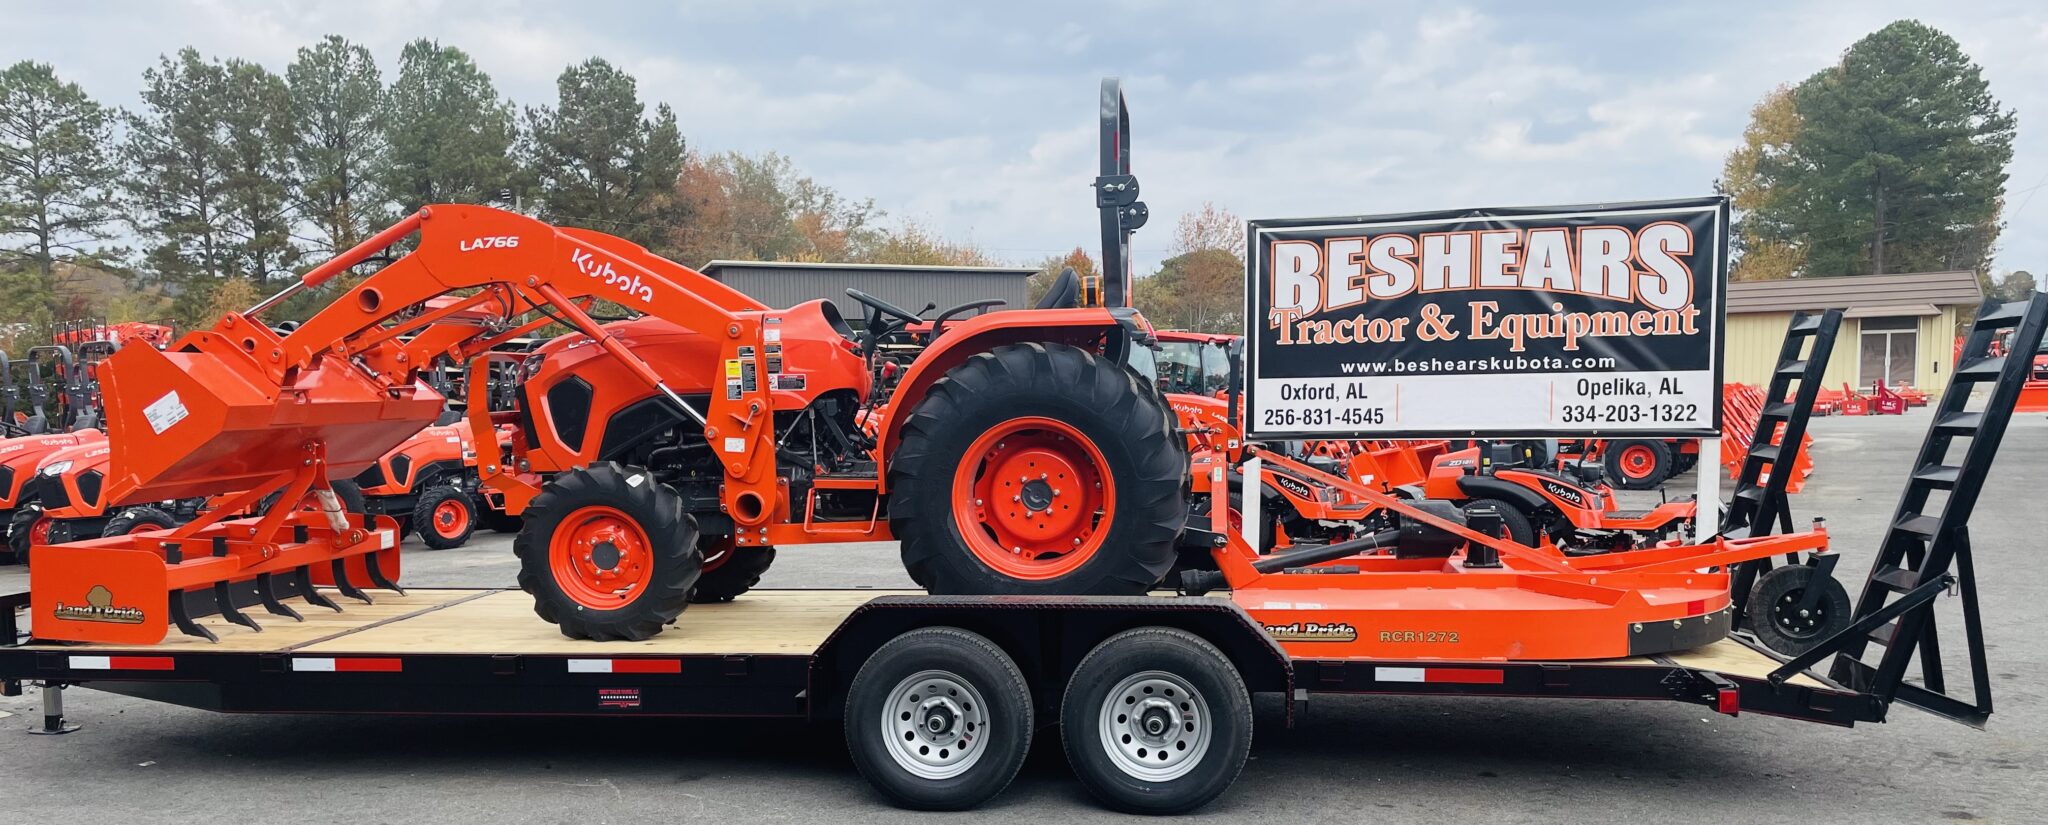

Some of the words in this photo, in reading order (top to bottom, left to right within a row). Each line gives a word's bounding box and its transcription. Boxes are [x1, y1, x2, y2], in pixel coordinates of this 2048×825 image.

[460, 236, 519, 252] LA766
[571, 248, 654, 303] Kubota
[1270, 220, 1695, 329] BESHEARS
[1268, 305, 1409, 346] Tractor
[1416, 302, 1460, 341] &
[1468, 301, 1700, 352] Equipment
[1341, 356, 1616, 373] www.beshearskubota.com
[1281, 383, 1340, 402] Oxford,
[1346, 382, 1368, 399] AL
[1577, 378, 1652, 399] Opelika,
[1659, 377, 1684, 395] AL
[1173, 402, 1203, 414] Kubota
[1264, 408, 1384, 425] 256-831-4545
[1562, 404, 1698, 423] 334-203-1322
[1280, 478, 1309, 496] Kubota
[1548, 483, 1581, 503] Kubota
[56, 601, 93, 616] Land
[104, 605, 143, 620] Pride
[1258, 622, 1299, 637] and
[1306, 623, 1356, 638] Pride
[1379, 631, 1459, 643] RCR1272
